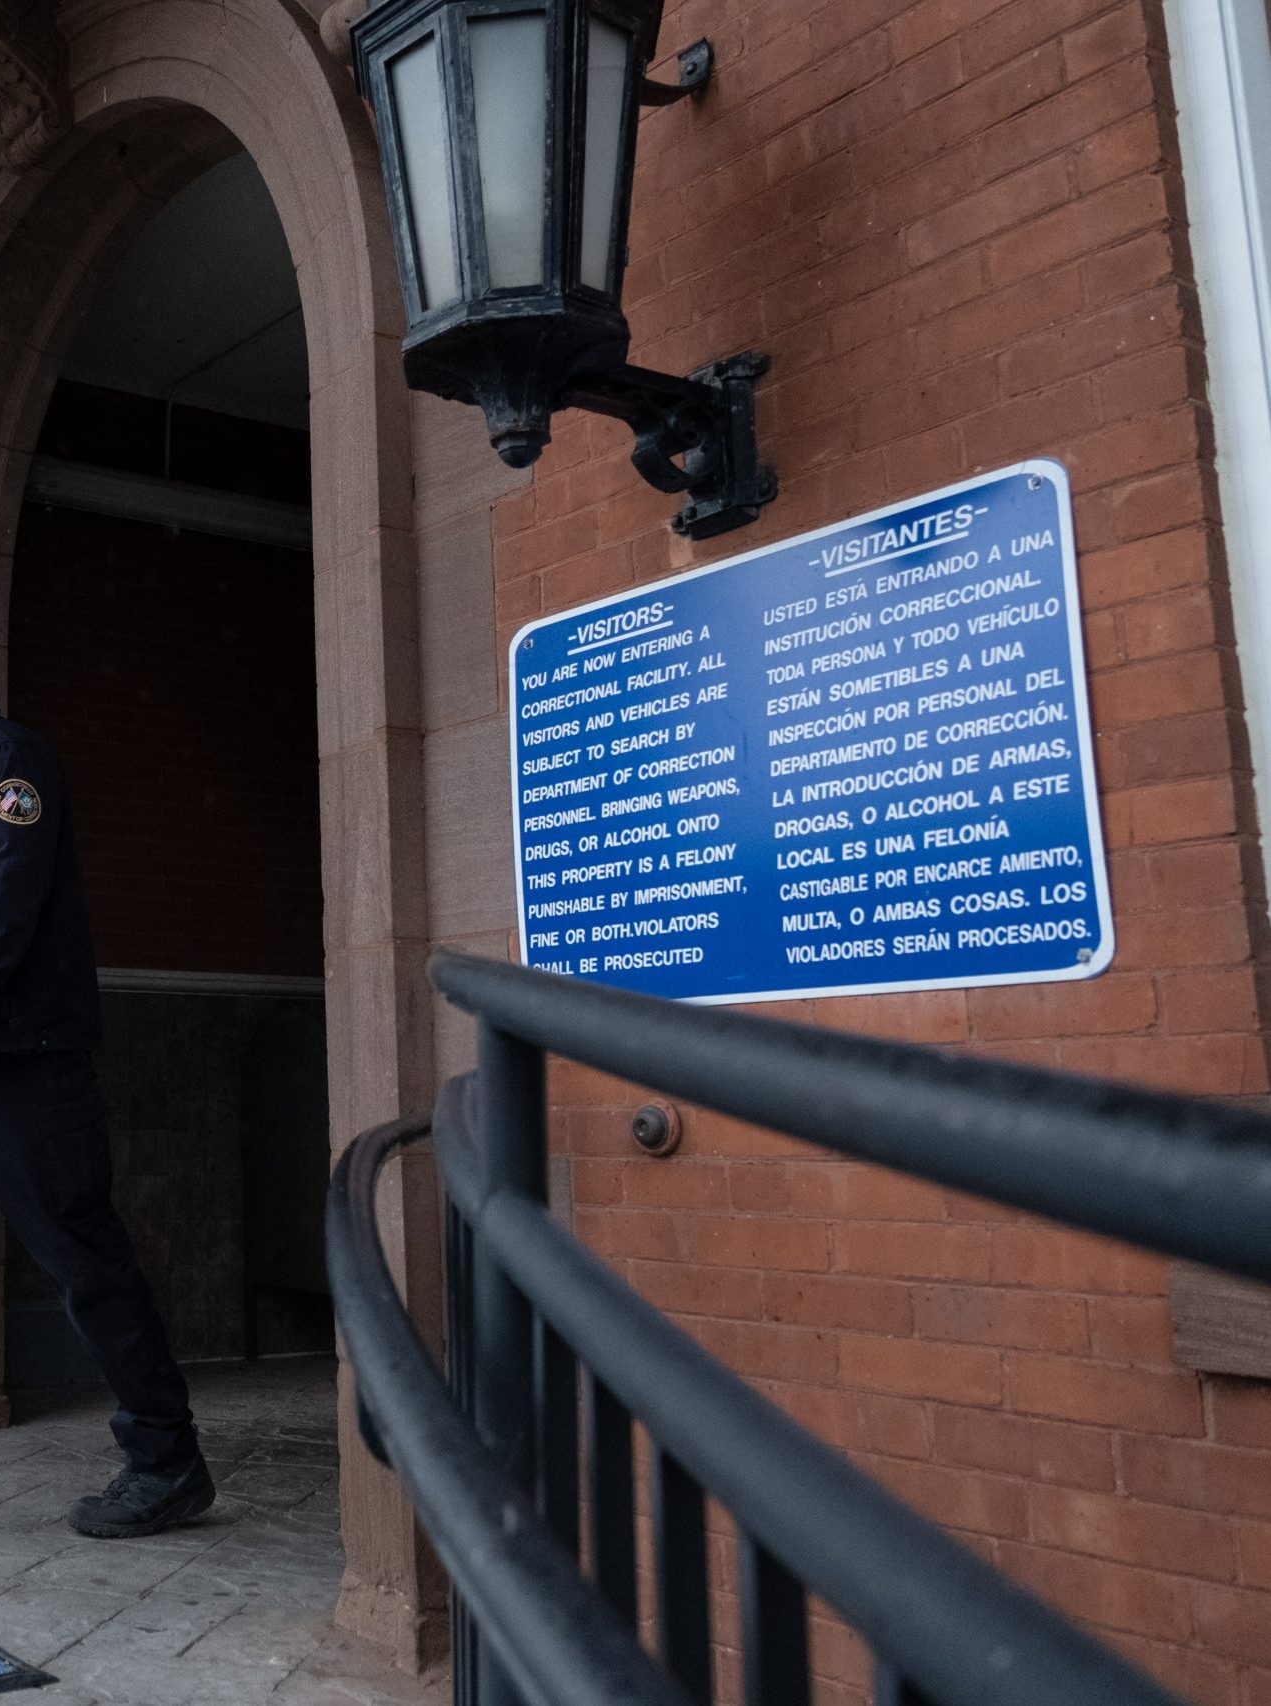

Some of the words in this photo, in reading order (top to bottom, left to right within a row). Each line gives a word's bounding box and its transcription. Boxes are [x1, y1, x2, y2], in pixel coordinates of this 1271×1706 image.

[764, 598, 817, 626] USTED
[825, 578, 868, 608] ESTÁ
[876, 551, 979, 594] ENTRANDO
[988, 545, 1001, 563] A
[1011, 530, 1054, 556] UNA
[765, 612, 871, 656] INSTITUCIÓN
[879, 570, 1041, 625] CORRECCIONAL.
[766, 662, 805, 685] TODA
[811, 642, 886, 674] PERSONA
[893, 636, 904, 654] Y
[911, 623, 959, 649] TODO
[967, 597, 1059, 635] VEHÍCULO
[521, 680, 622, 719] CORRECTIONAL
[627, 661, 691, 691] FACILITY.
[698, 652, 726, 672] ALL
[522, 672, 547, 691] YOU
[551, 662, 578, 683] ARE
[583, 652, 616, 674] NOW
[621, 629, 693, 663] ENTERING
[699, 625, 710, 641] A
[767, 687, 821, 716] ESTÁN
[829, 659, 949, 702] SOMETIBLES
[957, 654, 972, 672] A
[981, 641, 1025, 666] UNA
[522, 720, 580, 746] VISITORS
[585, 712, 615, 732] AND
[620, 692, 690, 723] VEHICLES
[696, 682, 728, 704] ARE
[769, 707, 866, 746] INSPECCIÓN
[873, 701, 910, 724] POR
[918, 678, 1017, 715] PERSONAL
[1026, 668, 1065, 692] DEL
[522, 749, 581, 776] SUBJECT
[586, 744, 605, 760] TO
[610, 728, 669, 756] SEARCH
[675, 722, 696, 741] BY
[771, 736, 897, 777] DEPARTAMENTO
[904, 730, 928, 751] DE
[936, 700, 1068, 744] CORRECCIÓN.
[523, 772, 608, 804] DEPARTMENT
[613, 767, 633, 785] OF
[638, 745, 735, 780] CORRECTION
[601, 792, 662, 818] BRINGING
[667, 777, 740, 805] WEAPONS,
[772, 789, 795, 808] LA
[802, 760, 943, 802] INTRODUCCIÓN
[952, 754, 980, 776] DE
[989, 738, 1071, 769] ARMAS,
[774, 811, 854, 839] DROGAS,
[861, 806, 877, 825] O
[885, 790, 981, 821] ALCOHOL
[989, 786, 1004, 804] A
[1013, 774, 1070, 800] ESTE
[525, 840, 573, 862] DRUGS,
[578, 835, 598, 852] OR
[603, 822, 671, 848] ALCOHOL
[677, 813, 720, 836] ONTO
[527, 872, 556, 890] THIS
[561, 860, 633, 885] PROPERTY
[639, 856, 653, 874] IS
[659, 854, 670, 870] A
[676, 843, 737, 868] FELONY
[777, 846, 835, 870] LOCAL
[842, 840, 867, 860] ES
[875, 834, 915, 856] UNA
[923, 814, 1010, 849] FELONÍA
[528, 895, 605, 919] PUNISHABLE
[611, 892, 628, 908] BY
[634, 875, 747, 905] IMPRISONMENT,
[780, 874, 869, 901] CASTIGABLE
[875, 868, 907, 889] POR
[914, 857, 992, 884] ENCARCE
[999, 846, 1082, 874] AMIENTO,
[783, 911, 841, 932] MULTA,
[850, 907, 865, 926] O
[873, 898, 941, 923] AMBAS
[950, 888, 1030, 915] COSAS.
[1041, 881, 1087, 905] LOS
[530, 931, 559, 948] FINE
[565, 928, 585, 944] OR
[579, 957, 598, 973] BE
[604, 947, 703, 971] PROSECUTED
[786, 938, 885, 964] VIOLADORES
[893, 928, 950, 955] SERÁN
[958, 918, 1091, 948] PROCESADOS.
